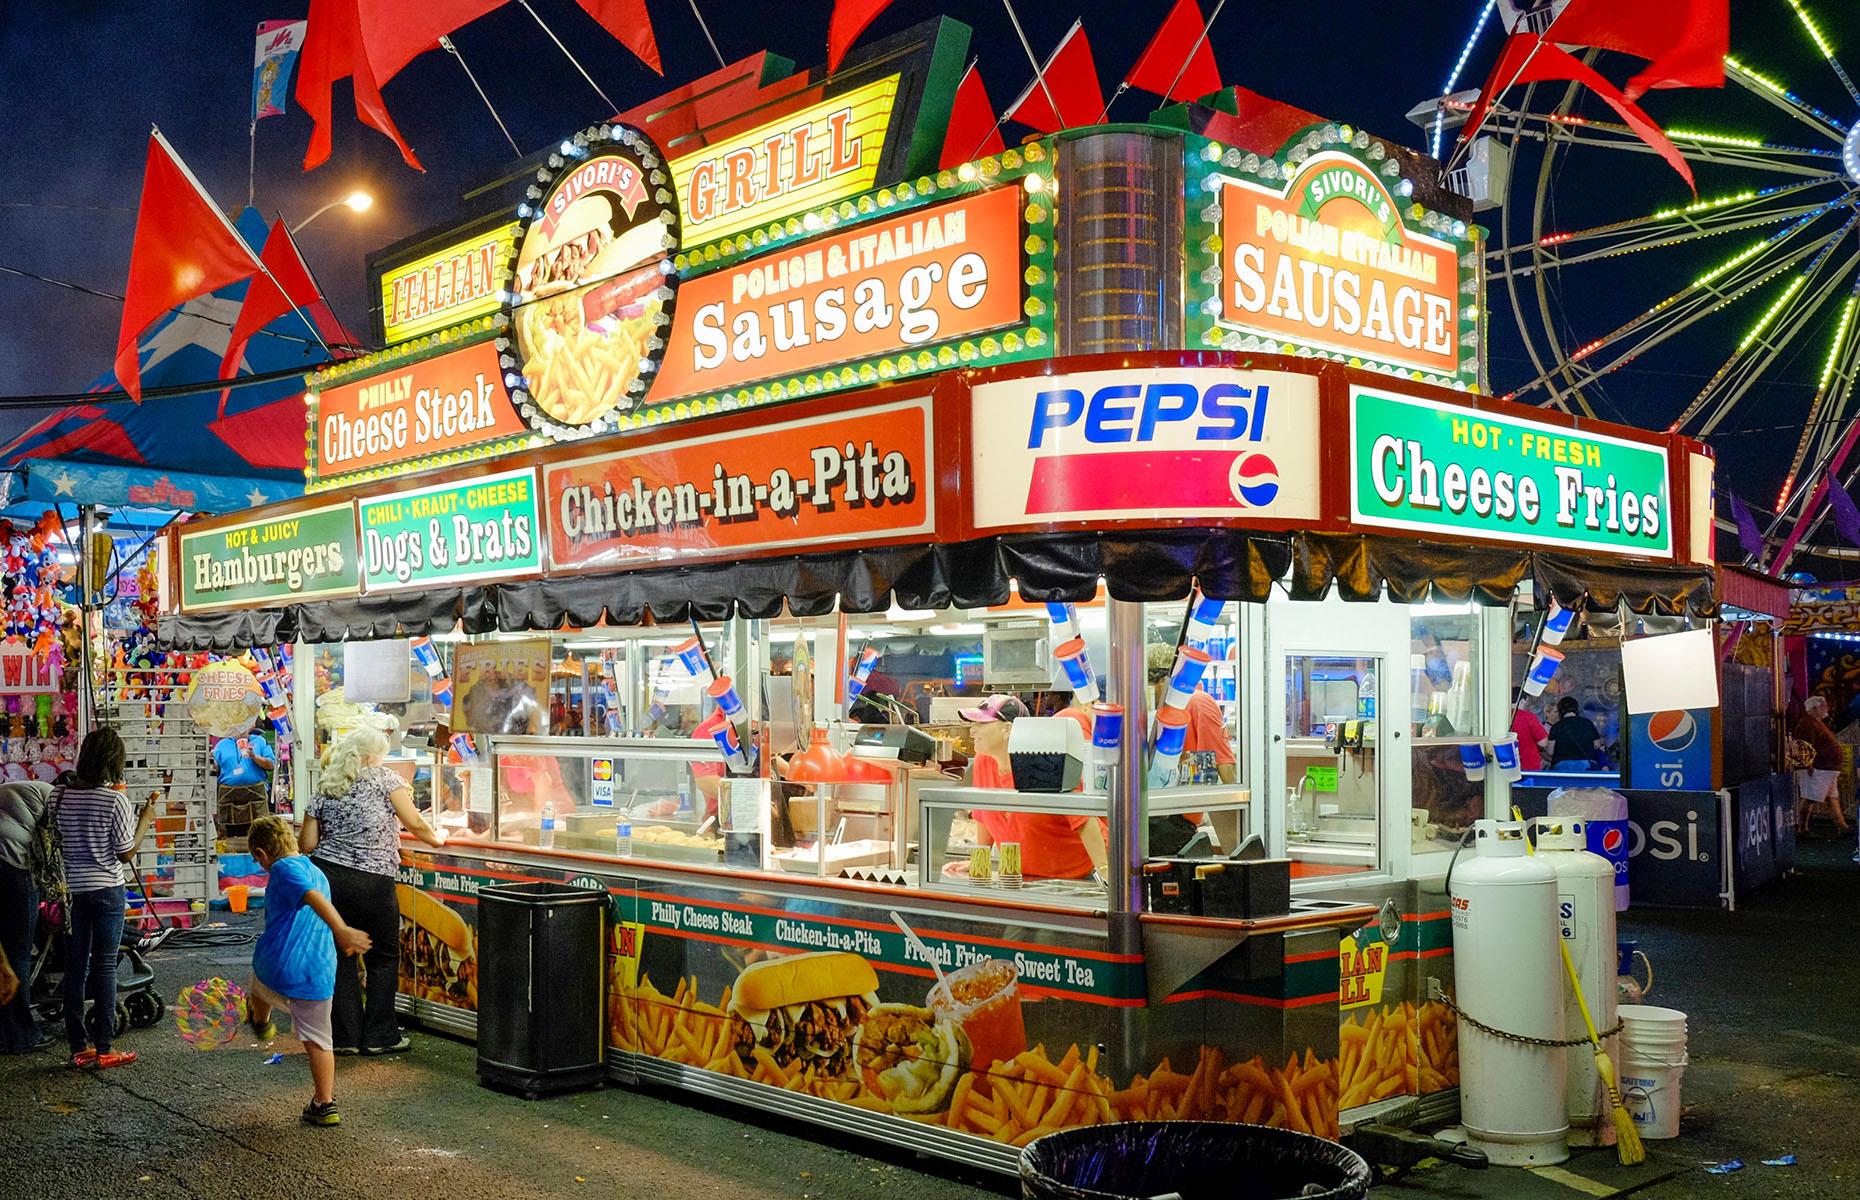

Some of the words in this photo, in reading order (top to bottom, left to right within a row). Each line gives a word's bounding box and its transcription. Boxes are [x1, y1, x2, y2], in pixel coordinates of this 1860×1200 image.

[554, 161, 633, 214] SIVORI'S
[687, 107, 863, 226] GRILL
[1311, 171, 1392, 224] SIVORI'S
[732, 250, 824, 304] POLISH
[827, 245, 849, 278] &
[850, 209, 967, 272] ITALIAN
[1256, 205, 1339, 257] POLISH
[1355, 232, 1437, 284] ITALIAN
[389, 241, 499, 327] ITALIAN
[1233, 240, 1452, 356] SAUSAGE
[692, 252, 989, 372] Sausage
[324, 402, 409, 465] Cheese
[415, 374, 496, 444] Steak
[358, 375, 413, 412] PHILLY
[1027, 384, 1269, 449] PEPSI
[1452, 418, 1503, 450] HOT
[1521, 433, 1602, 467] FRESH
[366, 502, 402, 526] CHILI
[412, 494, 459, 516] KRAUT
[467, 480, 529, 508] CHEESE
[560, 440, 912, 537] Chicken-in-a-Pita
[1370, 434, 1541, 523] Cheese
[1554, 465, 1660, 538] Fries
[225, 529, 248, 549] HOT
[251, 529, 259, 544] &
[261, 521, 300, 543] JUICY
[366, 525, 424, 582] Dogs
[428, 521, 450, 569] &
[451, 508, 533, 566] Brats
[193, 541, 343, 594] Hamburgers
[3, 655, 50, 687] WIN
[198, 671, 253, 684] CHEESE
[203, 686, 246, 700] FRIES
[595, 786, 612, 797] VISA
[434, 872, 460, 891] French
[460, 875, 480, 895] Fries
[651, 901, 680, 924] Philly
[682, 906, 719, 930] Cheese
[721, 911, 753, 936] Steak
[775, 918, 882, 956] Chicken-in-a-Pita
[1014, 952, 1061, 982] Sweet
[1065, 959, 1095, 987] Tea
